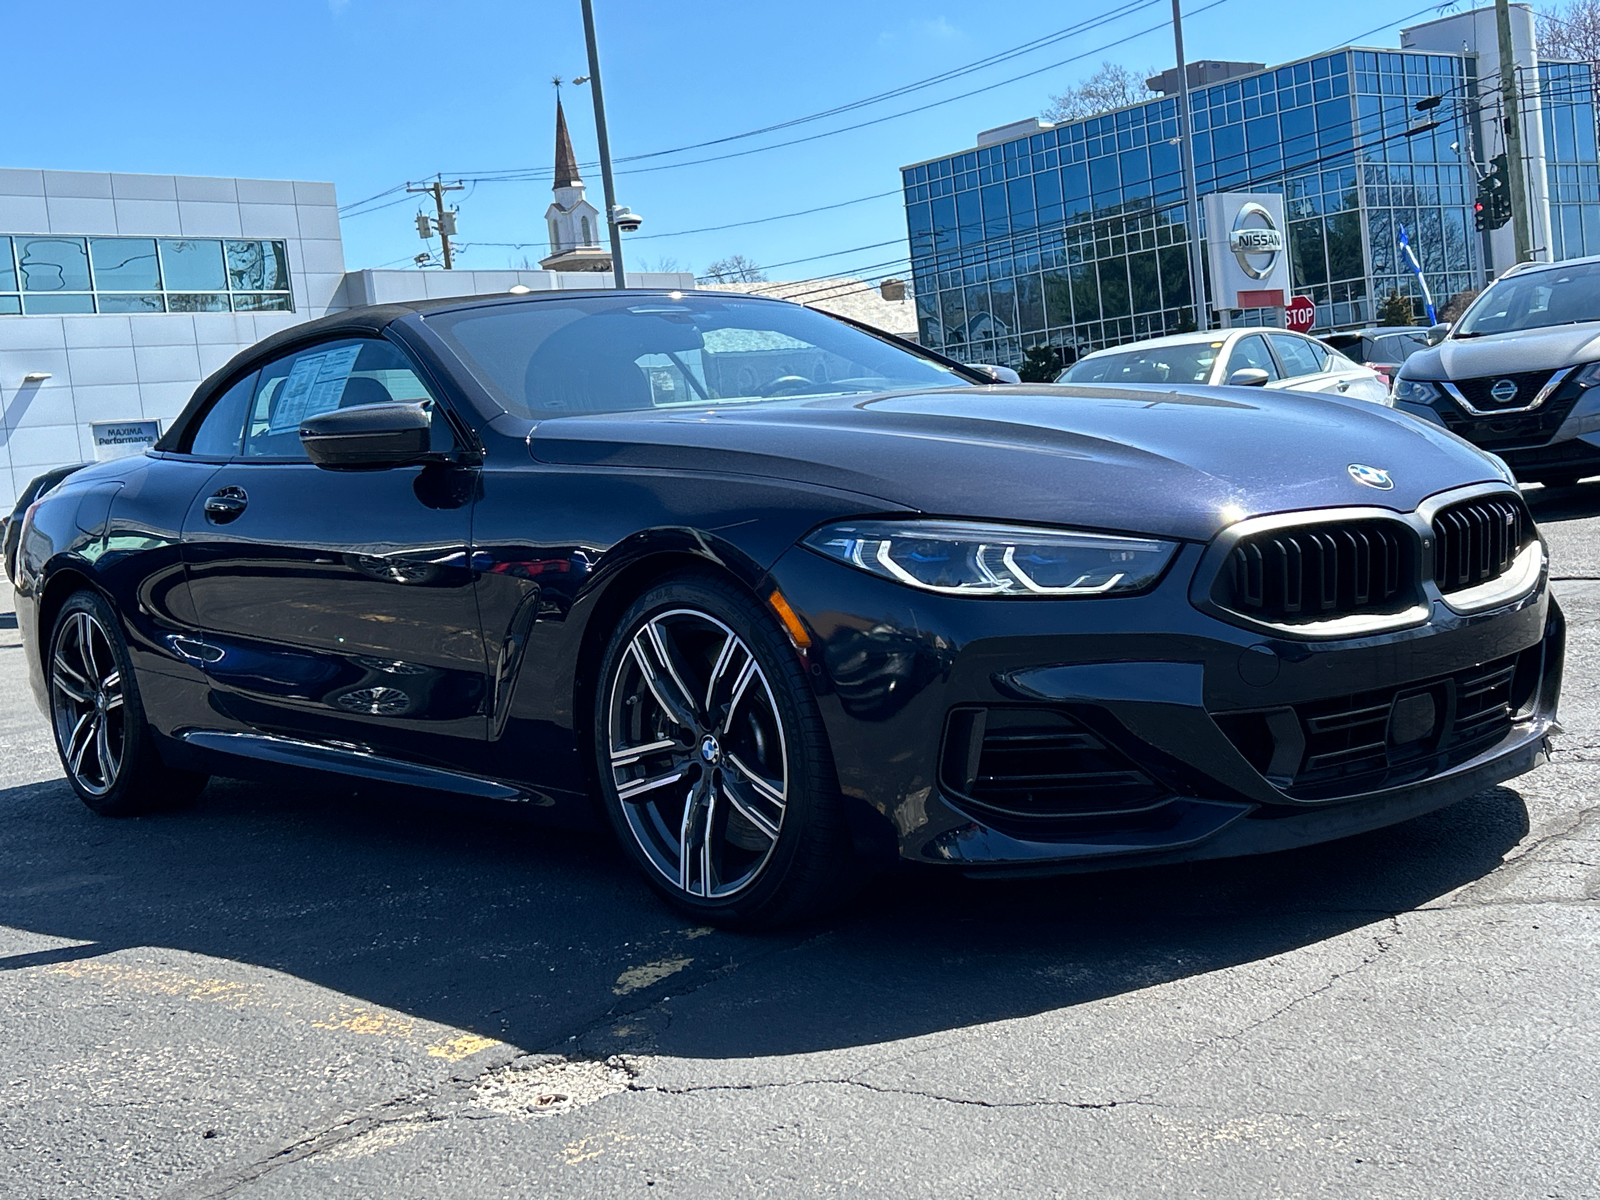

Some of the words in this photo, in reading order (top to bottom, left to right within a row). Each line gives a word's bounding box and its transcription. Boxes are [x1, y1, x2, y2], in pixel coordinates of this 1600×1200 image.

[1238, 234, 1280, 246] NISSAN
[1285, 307, 1314, 326] STOP
[107, 427, 143, 436] MAXIMA
[98, 436, 153, 445] Performance
